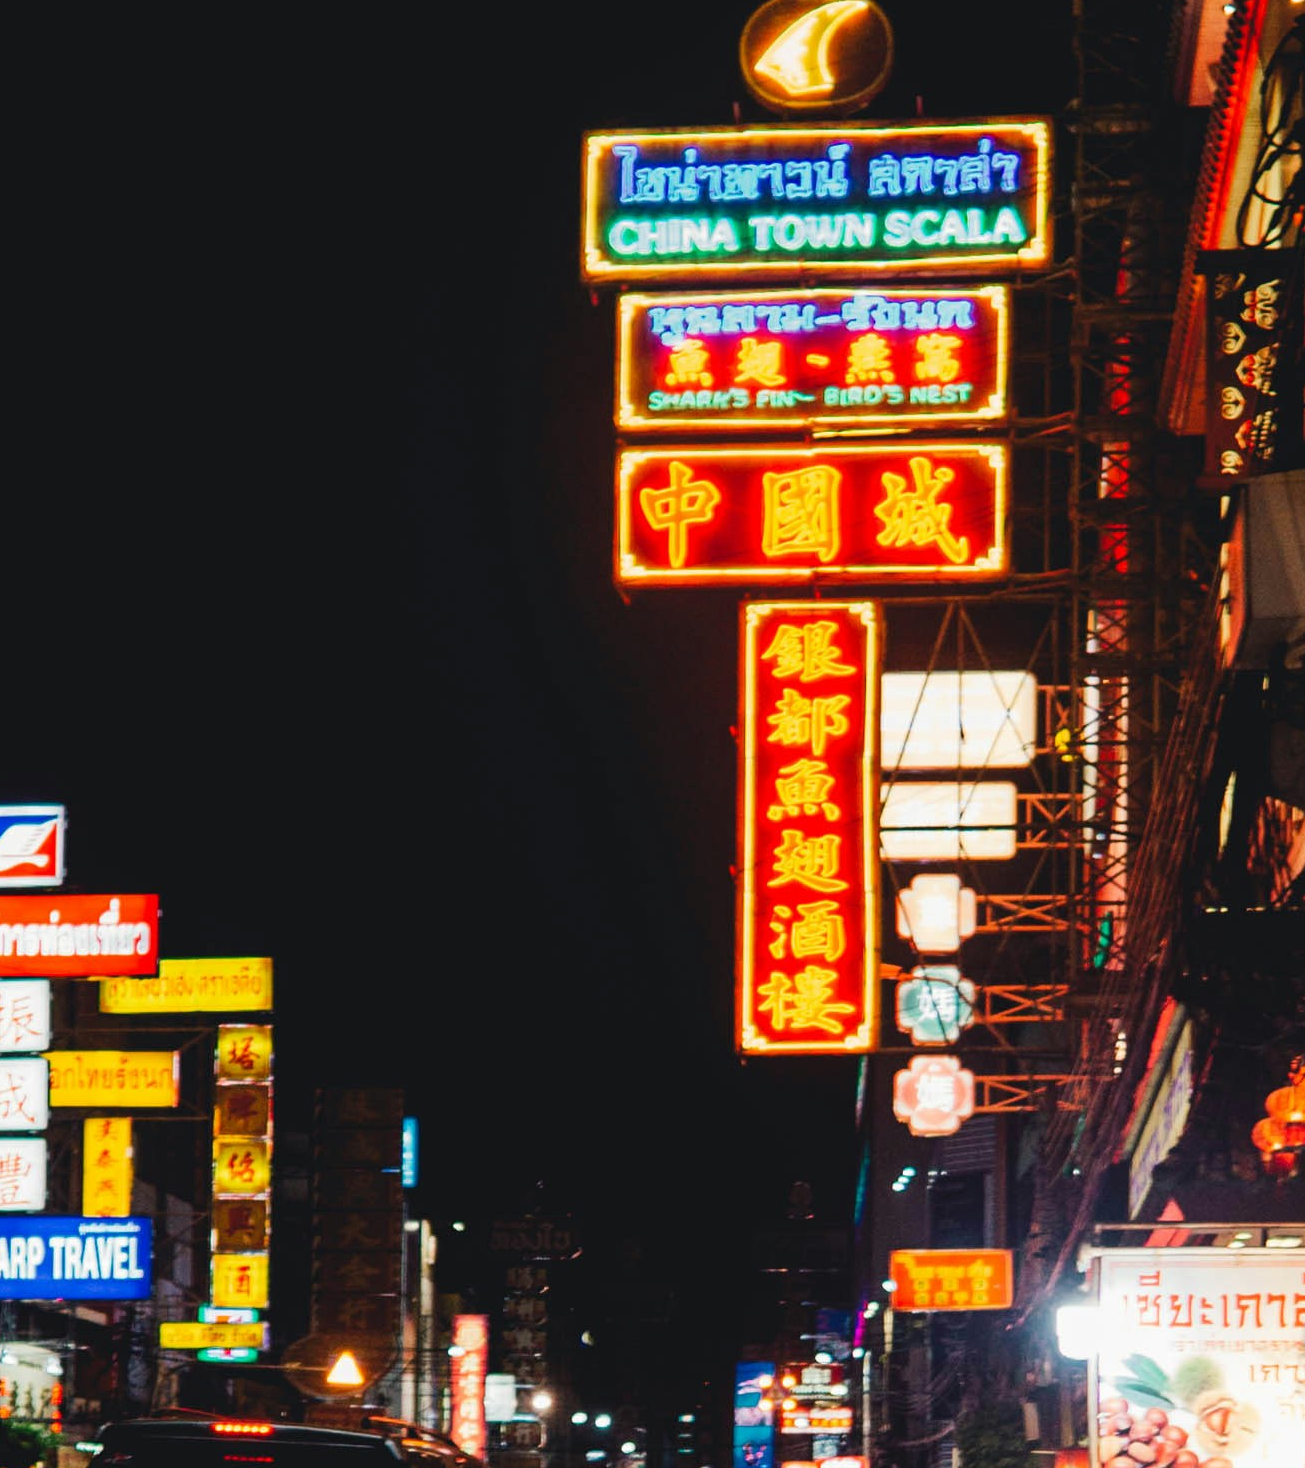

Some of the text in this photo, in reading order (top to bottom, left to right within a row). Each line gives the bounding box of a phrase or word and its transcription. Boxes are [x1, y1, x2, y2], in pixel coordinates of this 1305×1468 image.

[608, 207, 1026, 255] CHINA TOWN SCALA
[648, 388, 750, 410] SHARK'S
[823, 384, 904, 407] BIRD'S
[908, 382, 975, 405] NEST
[639, 456, 969, 569] 中國城
[758, 617, 858, 1036] 銀都魚翅酒樓
[51, 1235, 145, 1281] TRAVEL
